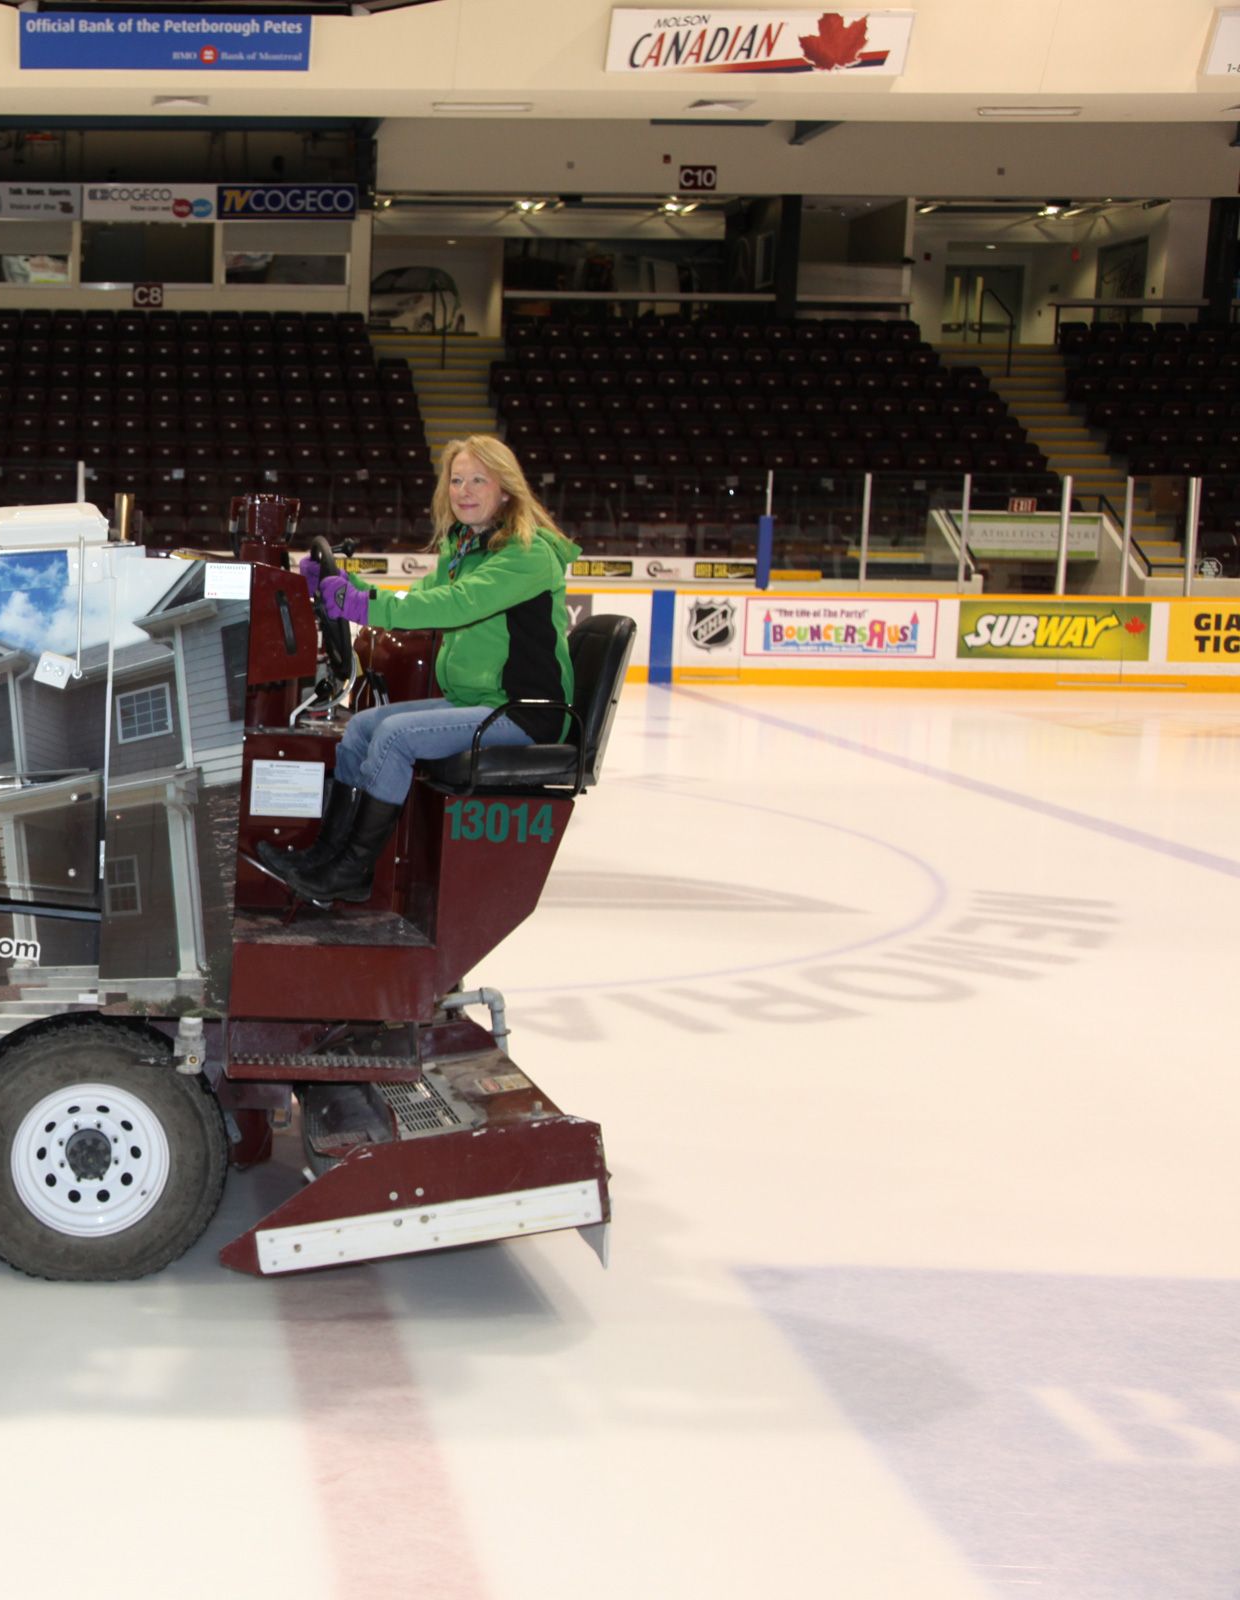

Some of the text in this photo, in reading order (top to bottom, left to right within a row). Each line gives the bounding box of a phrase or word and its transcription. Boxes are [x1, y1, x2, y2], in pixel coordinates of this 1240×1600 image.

[25, 19, 303, 37] Official Bank of the Peterborough Petes
[653, 14, 711, 29] MOLSON
[629, 22, 785, 68] CANADIAN
[172, 52, 303, 61] BMO Bank of Montreal
[680, 169, 717, 188] C10
[110, 188, 172, 201] COGECO
[134, 287, 162, 304] C8
[981, 529, 1045, 538] ATHLETICS
[1050, 530, 1097, 539] CNTRE
[796, 608, 810, 618] Life
[823, 609, 838, 618] The
[696, 612, 728, 641] NHL
[963, 610, 1120, 650] SUBWAY
[444, 799, 554, 843] 13014
[508, 889, 1125, 1043] MEMORIA
